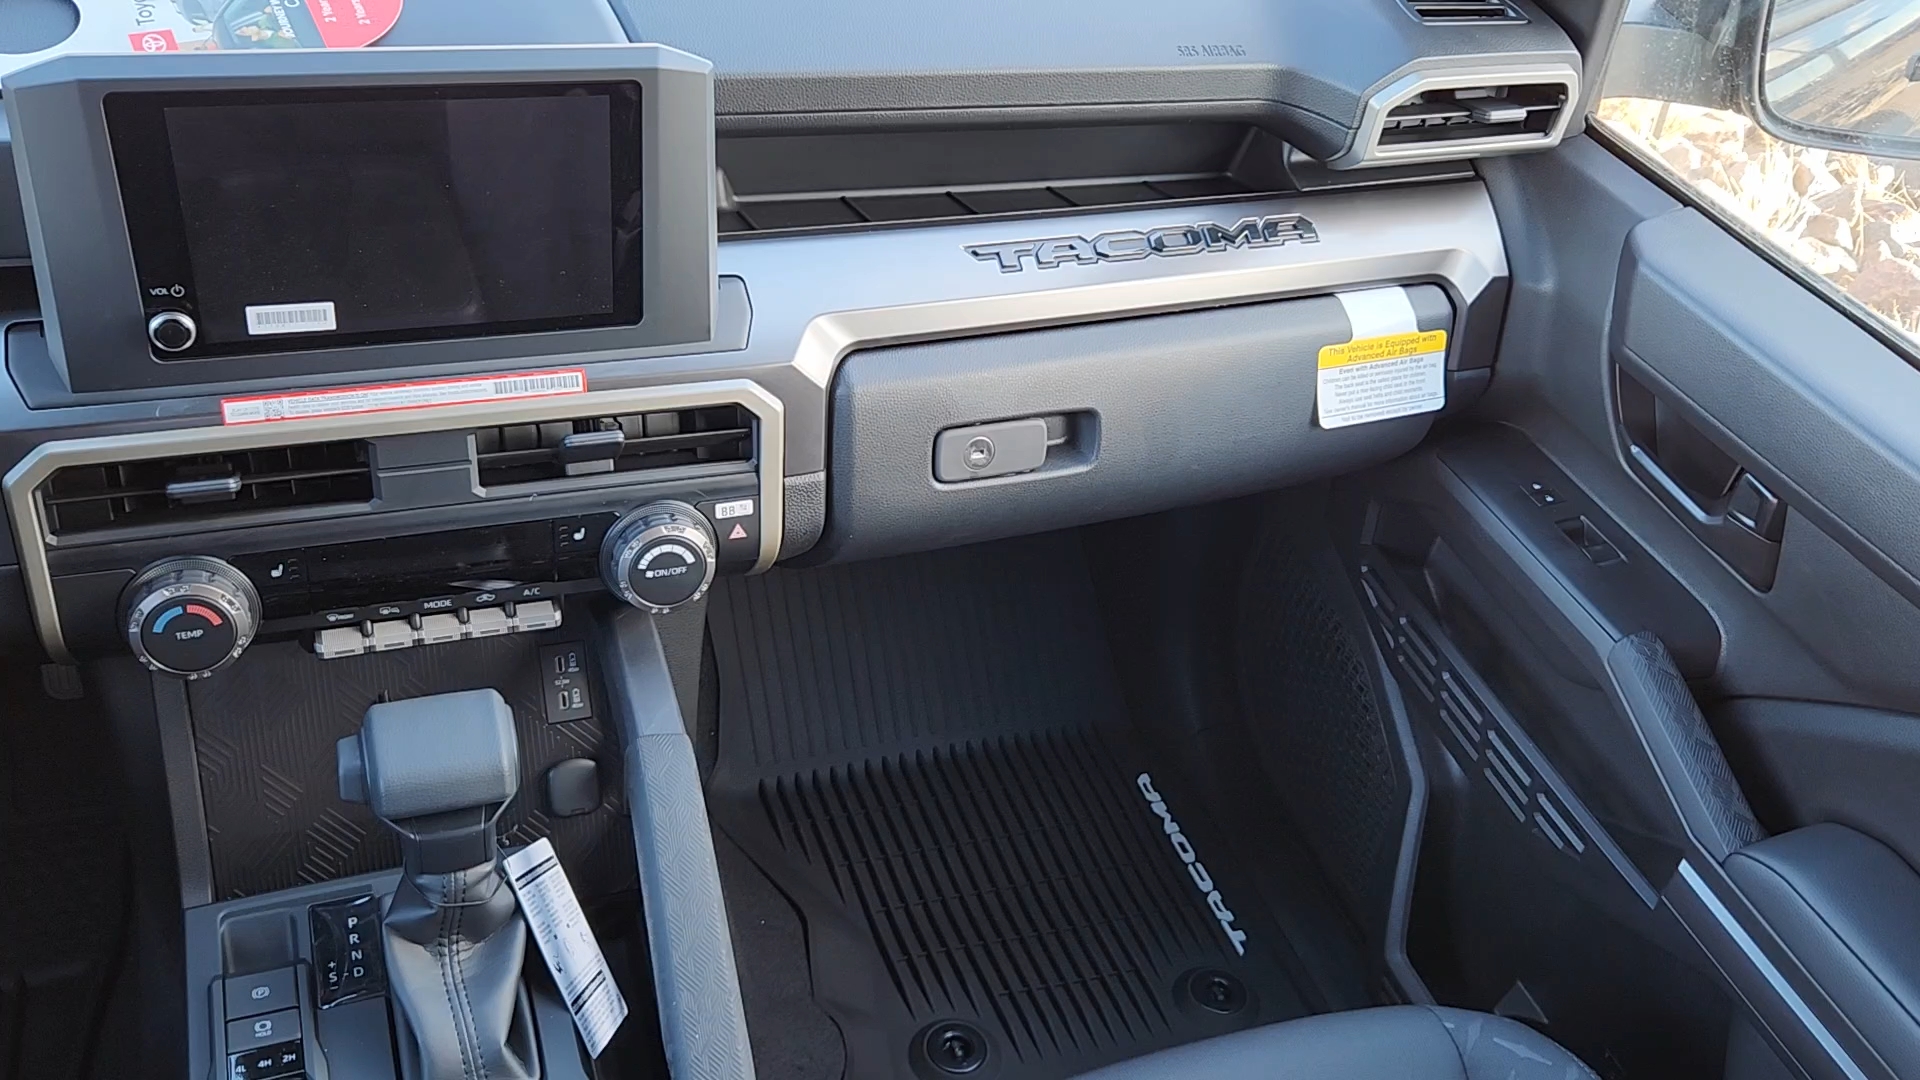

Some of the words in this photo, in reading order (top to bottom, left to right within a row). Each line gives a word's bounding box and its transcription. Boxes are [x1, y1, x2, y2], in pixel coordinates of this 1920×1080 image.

[959, 212, 1321, 274] TACOMA
[149, 288, 169, 296] VOL
[1329, 347, 1345, 356] This
[1348, 343, 1374, 354] Vehicle
[1385, 337, 1419, 349] Equipped
[1422, 334, 1437, 343] with
[1346, 351, 1385, 363] Advanced
[1387, 349, 1397, 357] Air
[1399, 346, 1417, 357] Bags
[1355, 365, 1369, 373] with
[1369, 361, 1398, 370] Advanced
[1409, 357, 1424, 365] Bags
[654, 566, 687, 577] ON/OFF
[523, 587, 540, 597] A/C
[424, 599, 452, 609] MODE
[175, 629, 203, 640] TEMP
[1137, 773, 1246, 956] TACOMA
[347, 917, 358, 929] P
[349, 933, 360, 944] R
[351, 950, 363, 960] N
[328, 971, 338, 982] S
[353, 966, 365, 978] D
[255, 1030, 272, 1038] HOLD
[235, 1065, 247, 1073] 4L
[257, 1058, 272, 1068] 4H
[282, 1053, 296, 1063] 2H
